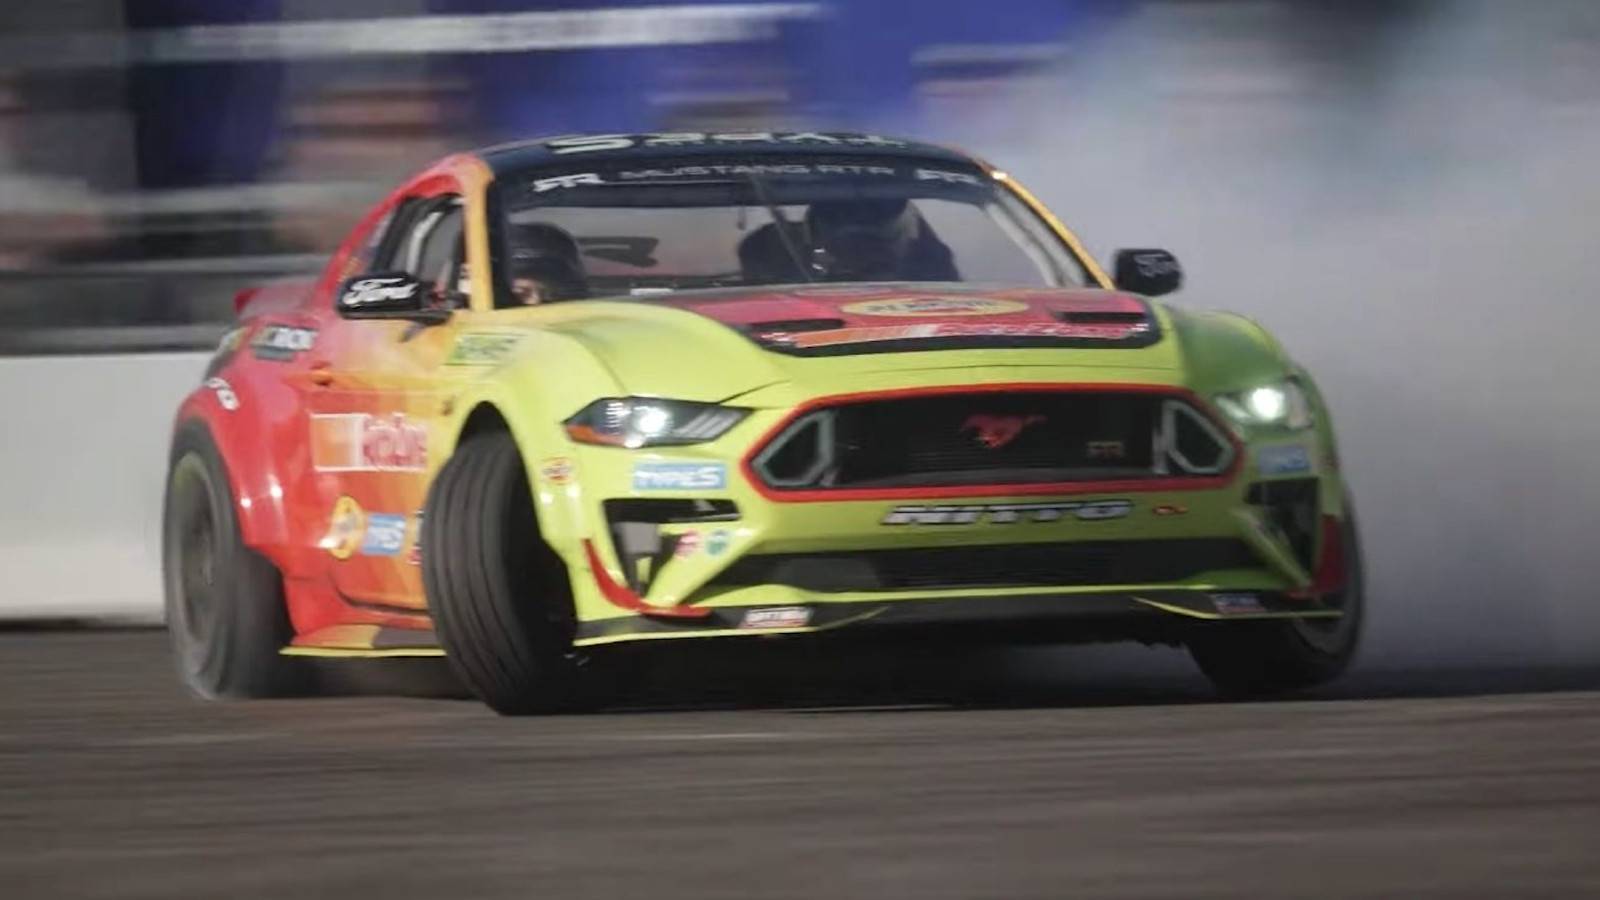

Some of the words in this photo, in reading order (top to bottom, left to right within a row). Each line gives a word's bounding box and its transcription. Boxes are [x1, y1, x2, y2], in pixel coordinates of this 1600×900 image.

[618, 164, 810, 180] MUSTANG
[814, 164, 896, 175] RTR
[342, 277, 419, 308] Ford
[880, 499, 1134, 526] NITTO
